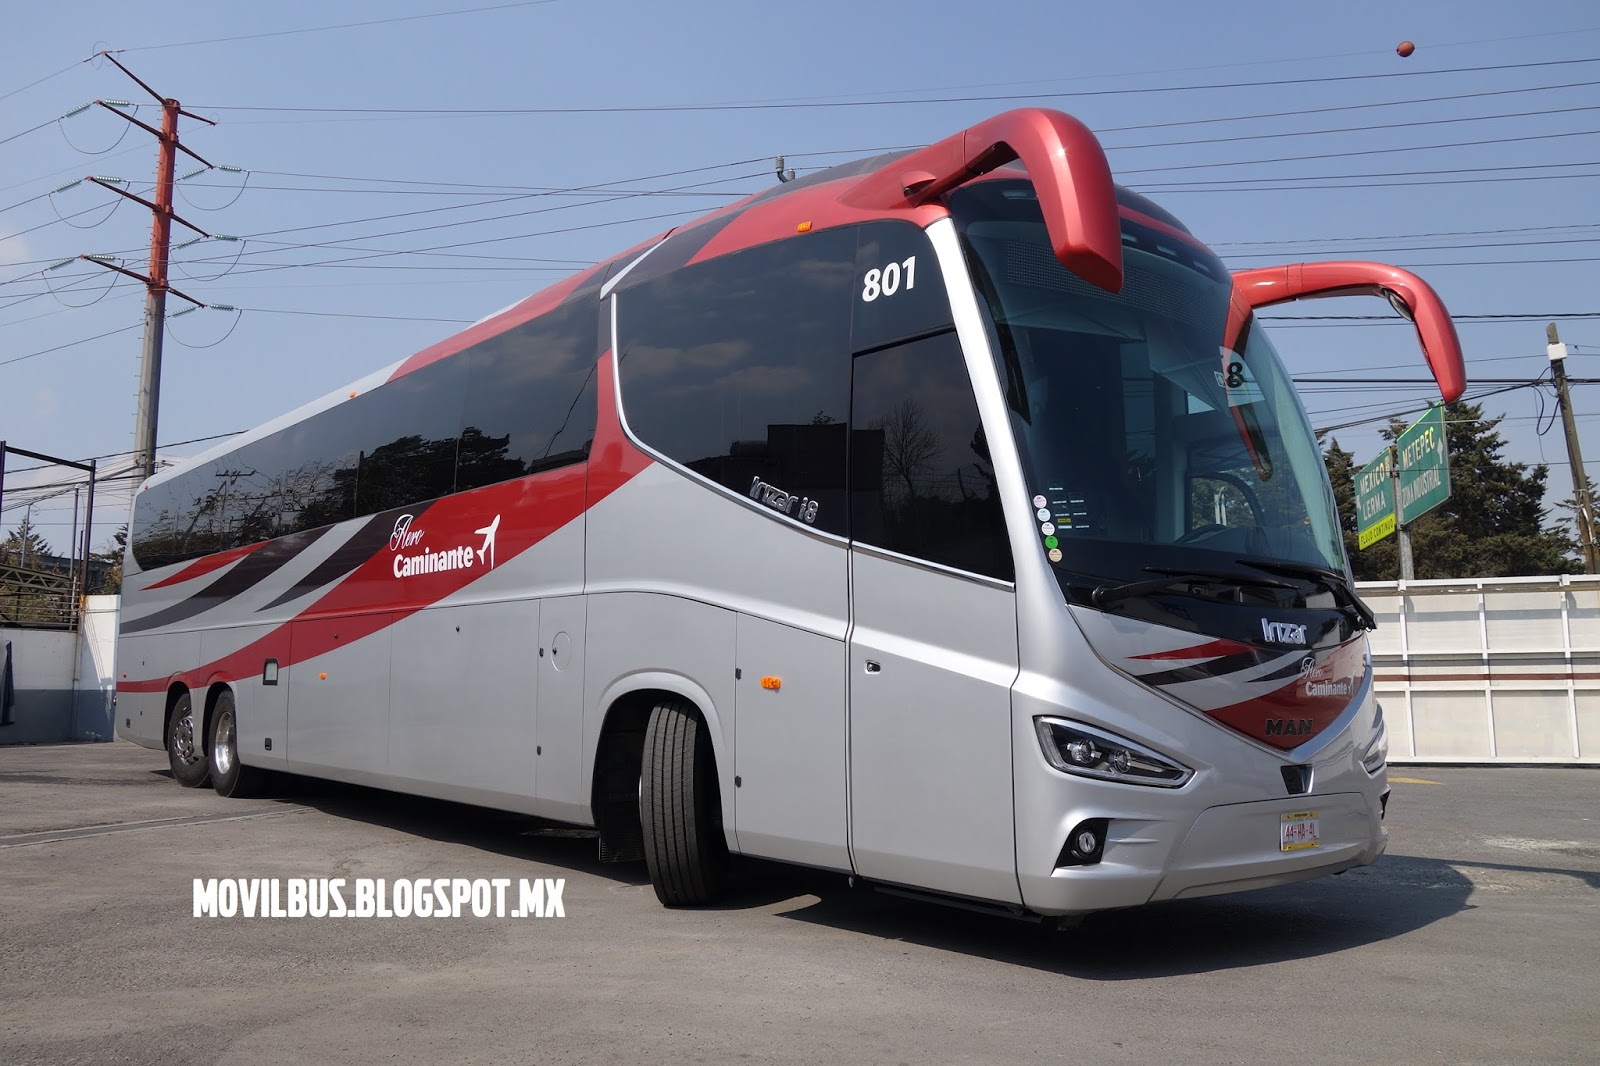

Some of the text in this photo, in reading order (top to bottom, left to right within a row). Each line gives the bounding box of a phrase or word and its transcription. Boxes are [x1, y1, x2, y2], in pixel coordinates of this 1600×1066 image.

[862, 255, 916, 302] 801
[1226, 361, 1244, 388] 8
[1402, 426, 1435, 470] METEPEC
[1360, 463, 1384, 496] MEXICO
[1402, 464, 1441, 508] ZONA INDUSTRIAL
[798, 496, 819, 523] i8
[1362, 491, 1386, 521] LERMA
[389, 513, 425, 552] Aero
[1360, 518, 1394, 545] FLUJO CONTINUO
[393, 545, 475, 578] Caminante
[1300, 657, 1325, 679] Aero
[1305, 680, 1348, 697] Caminante
[1265, 719, 1313, 736] MAN
